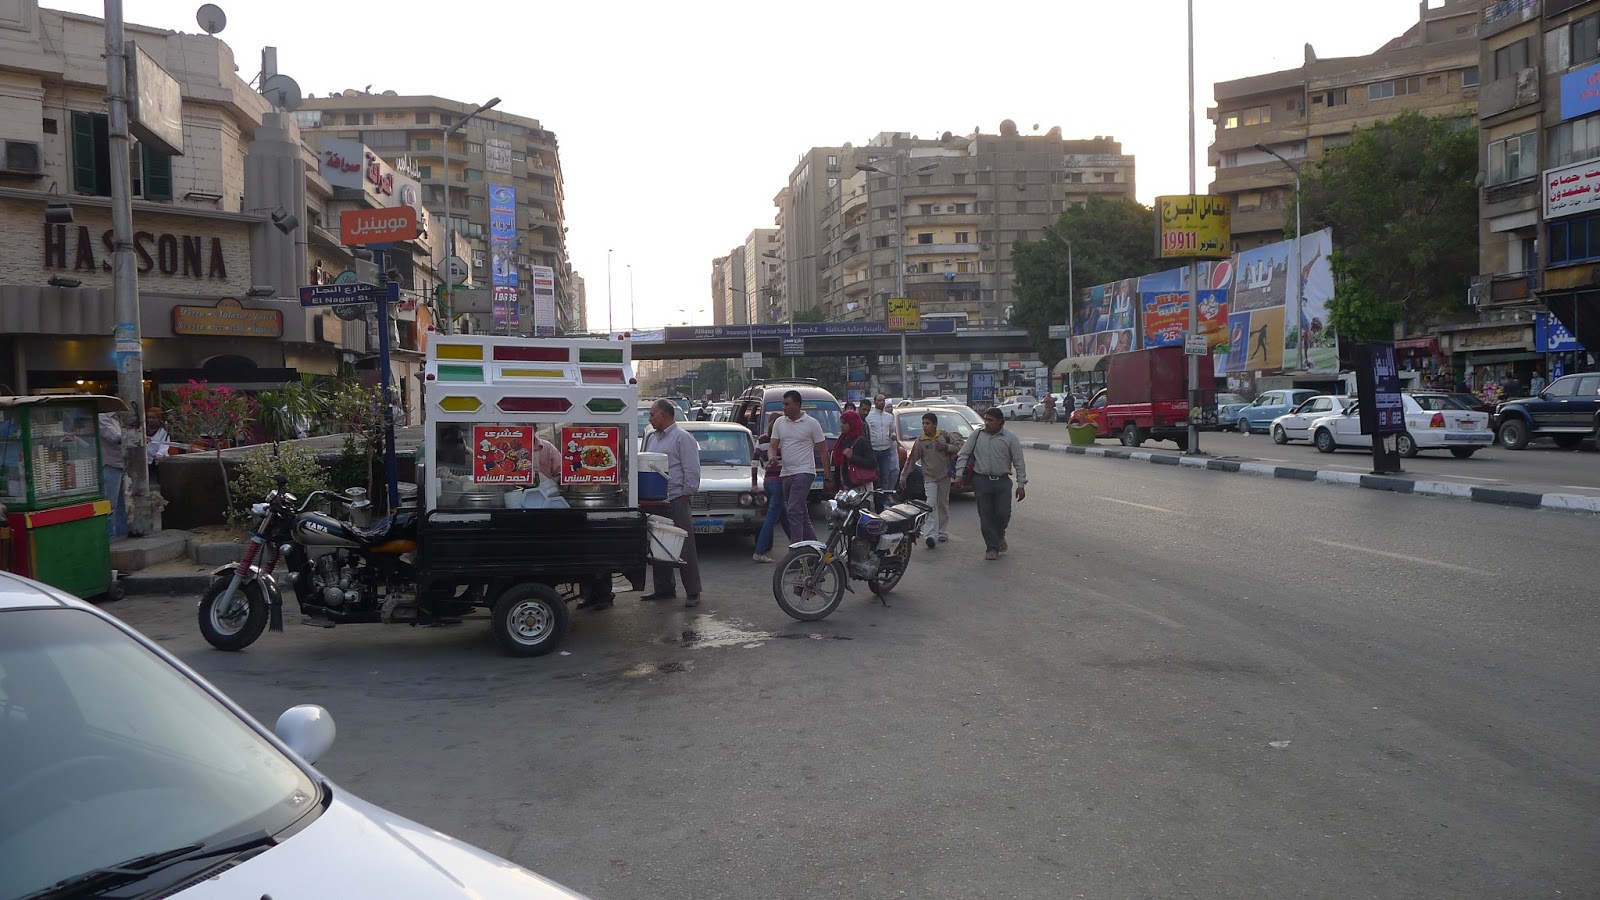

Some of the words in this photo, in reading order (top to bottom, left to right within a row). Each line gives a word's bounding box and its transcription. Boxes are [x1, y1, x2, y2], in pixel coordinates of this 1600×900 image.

[1162, 196, 1198, 223] البرج
[350, 217, 408, 235] موبينيل
[1162, 231, 1197, 250] 19911
[310, 286, 341, 296] النجار
[344, 285, 371, 294] شارع
[325, 295, 355, 304] Nagar
[889, 317, 905, 326] 19911
[505, 472, 530, 482] أحمد
[591, 472, 615, 482] أحمد
[305, 521, 328, 533] KAWA
